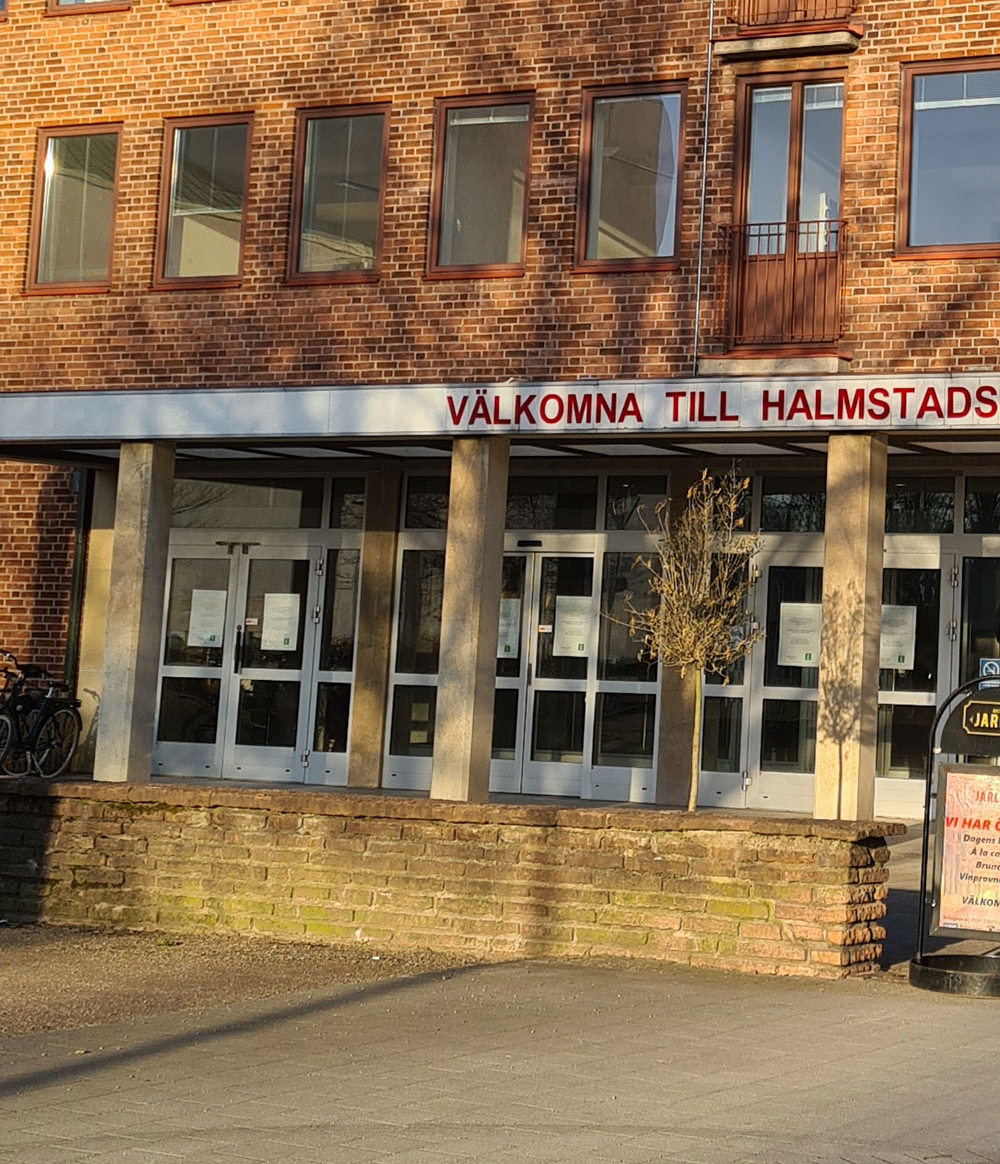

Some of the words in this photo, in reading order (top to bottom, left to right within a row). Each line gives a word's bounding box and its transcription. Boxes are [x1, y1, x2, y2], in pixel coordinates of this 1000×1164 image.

[447, 385, 643, 424] VÄLKOMNA
[666, 391, 739, 422] TILL
[761, 385, 999, 421] HALMSTADS
[945, 816, 959, 828] VI
[961, 818, 992, 831] HAR
[963, 834, 996, 846] Dagens
[979, 848, 988, 857] la
